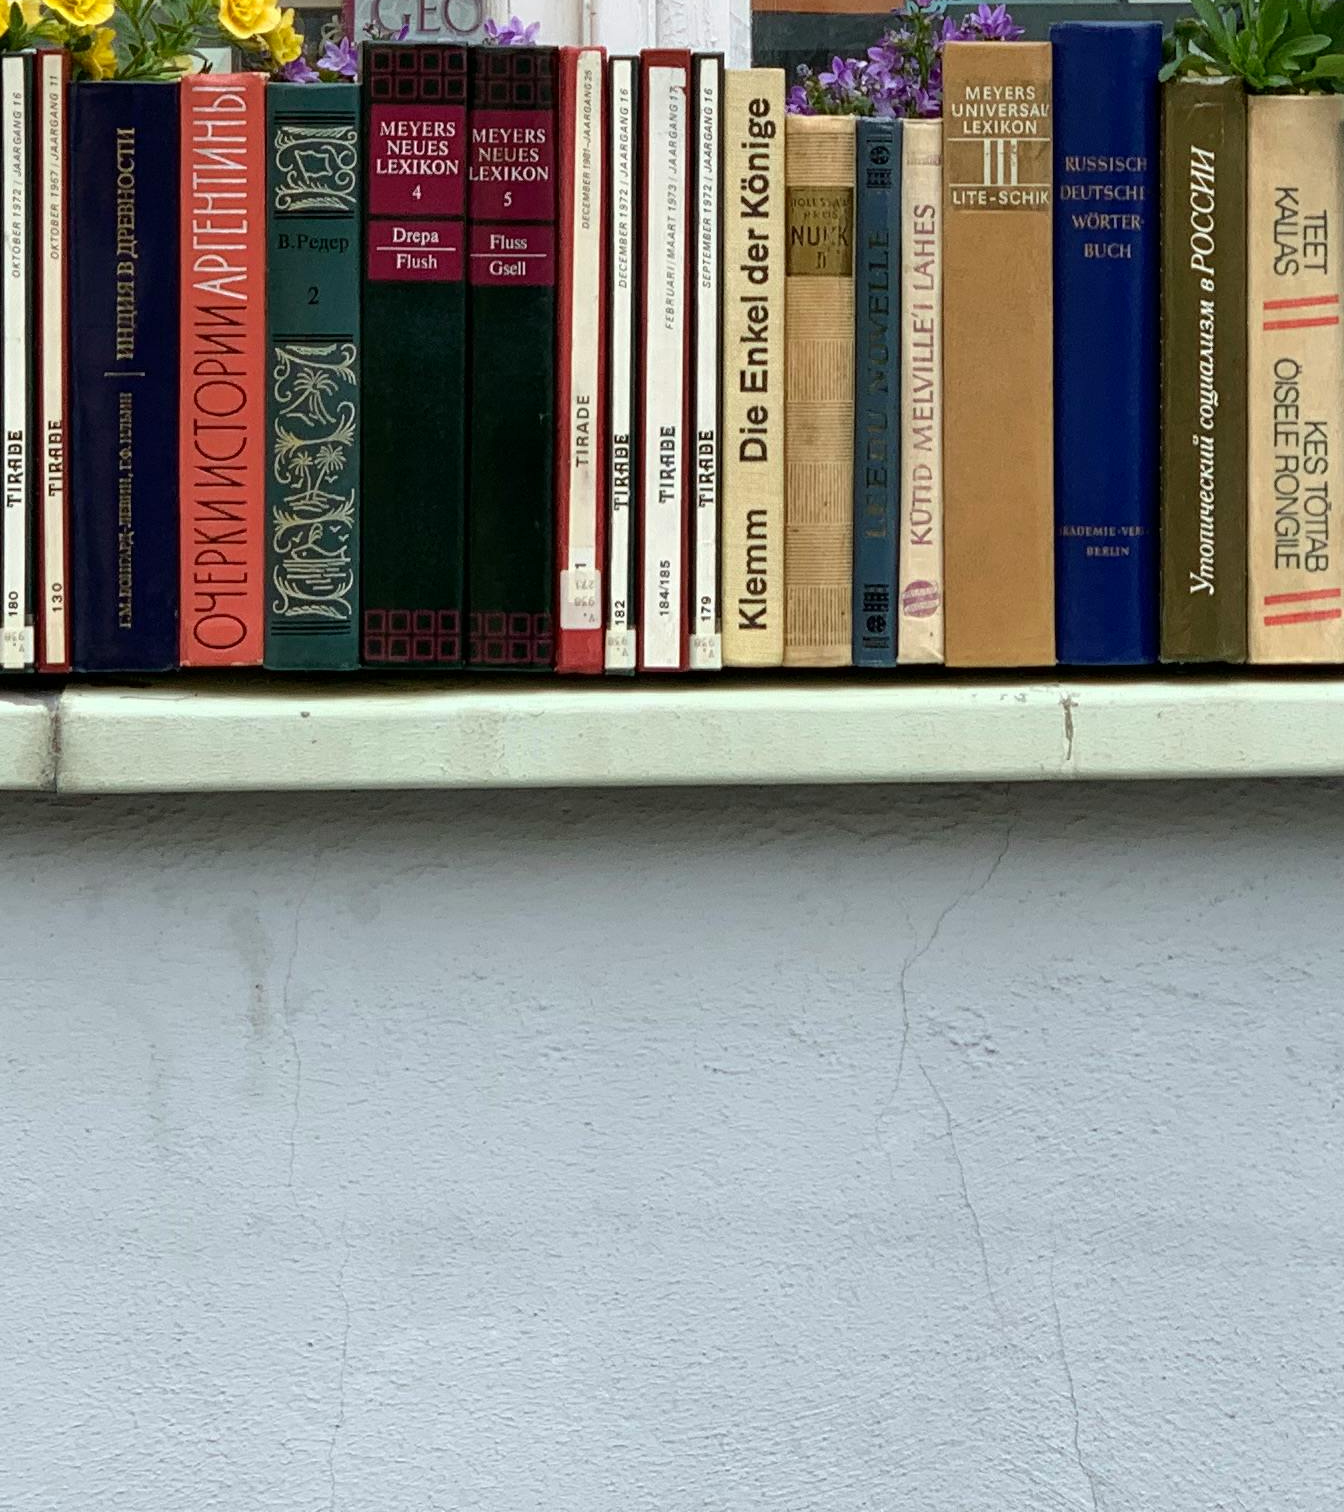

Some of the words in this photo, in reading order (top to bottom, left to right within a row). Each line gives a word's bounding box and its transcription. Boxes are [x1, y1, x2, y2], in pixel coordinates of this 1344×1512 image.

[963, 119, 1038, 134] LEXIKON
[965, 85, 1036, 100] MEYERS
[11, 110, 22, 178] JAARGANG
[379, 121, 456, 138] MEYERS
[386, 140, 449, 156] NEUES
[471, 128, 547, 144] MEYERS
[478, 147, 540, 163] NEUES
[740, 97, 777, 220] Könige
[116, 127, 138, 259] ДРЕВНОСТИ
[191, 85, 248, 301] АРГЕНТИНЫ
[376, 159, 459, 176] LEXIKON
[468, 165, 550, 182] LEXIKON
[1064, 156, 1147, 172] RUSSISCH
[12, 188, 22, 217] 1972
[392, 228, 440, 245] Drepa
[1189, 144, 1216, 276] РОССИИ
[1273, 186, 1299, 276] KALLAS
[11, 221, 22, 279] OKTOBER
[395, 254, 438, 270] Flush
[489, 234, 528, 250] Fluss
[489, 260, 527, 277] Gsell
[702, 218, 713, 289] SEPTEMBER
[740, 227, 770, 286] der
[912, 204, 936, 291] LAHES
[1084, 243, 1132, 259] BUCH
[1303, 209, 1328, 276] TEET
[1200, 278, 1215, 292] в
[116, 280, 136, 361] ИНДИЯ
[739, 296, 769, 393] Enkel
[192, 305, 249, 488] ИСТОРИИ
[1197, 300, 1219, 431] социализм
[48, 419, 64, 497] TIRADE
[575, 394, 591, 469] TIRADE
[658, 425, 677, 504] TIRADE
[739, 405, 768, 463] Die
[1303, 420, 1328, 475] KES
[6, 430, 23, 508] TIRADE
[613, 434, 630, 512] TIRADE
[698, 429, 715, 508] TIRADE
[910, 464, 935, 546] KÜTID
[1189, 434, 1216, 596] Утопический
[1273, 454, 1302, 570] RONGILE
[192, 500, 249, 650] ОЧЕРКИ
[738, 508, 768, 631] Klemm
[8, 591, 19, 617] 180
